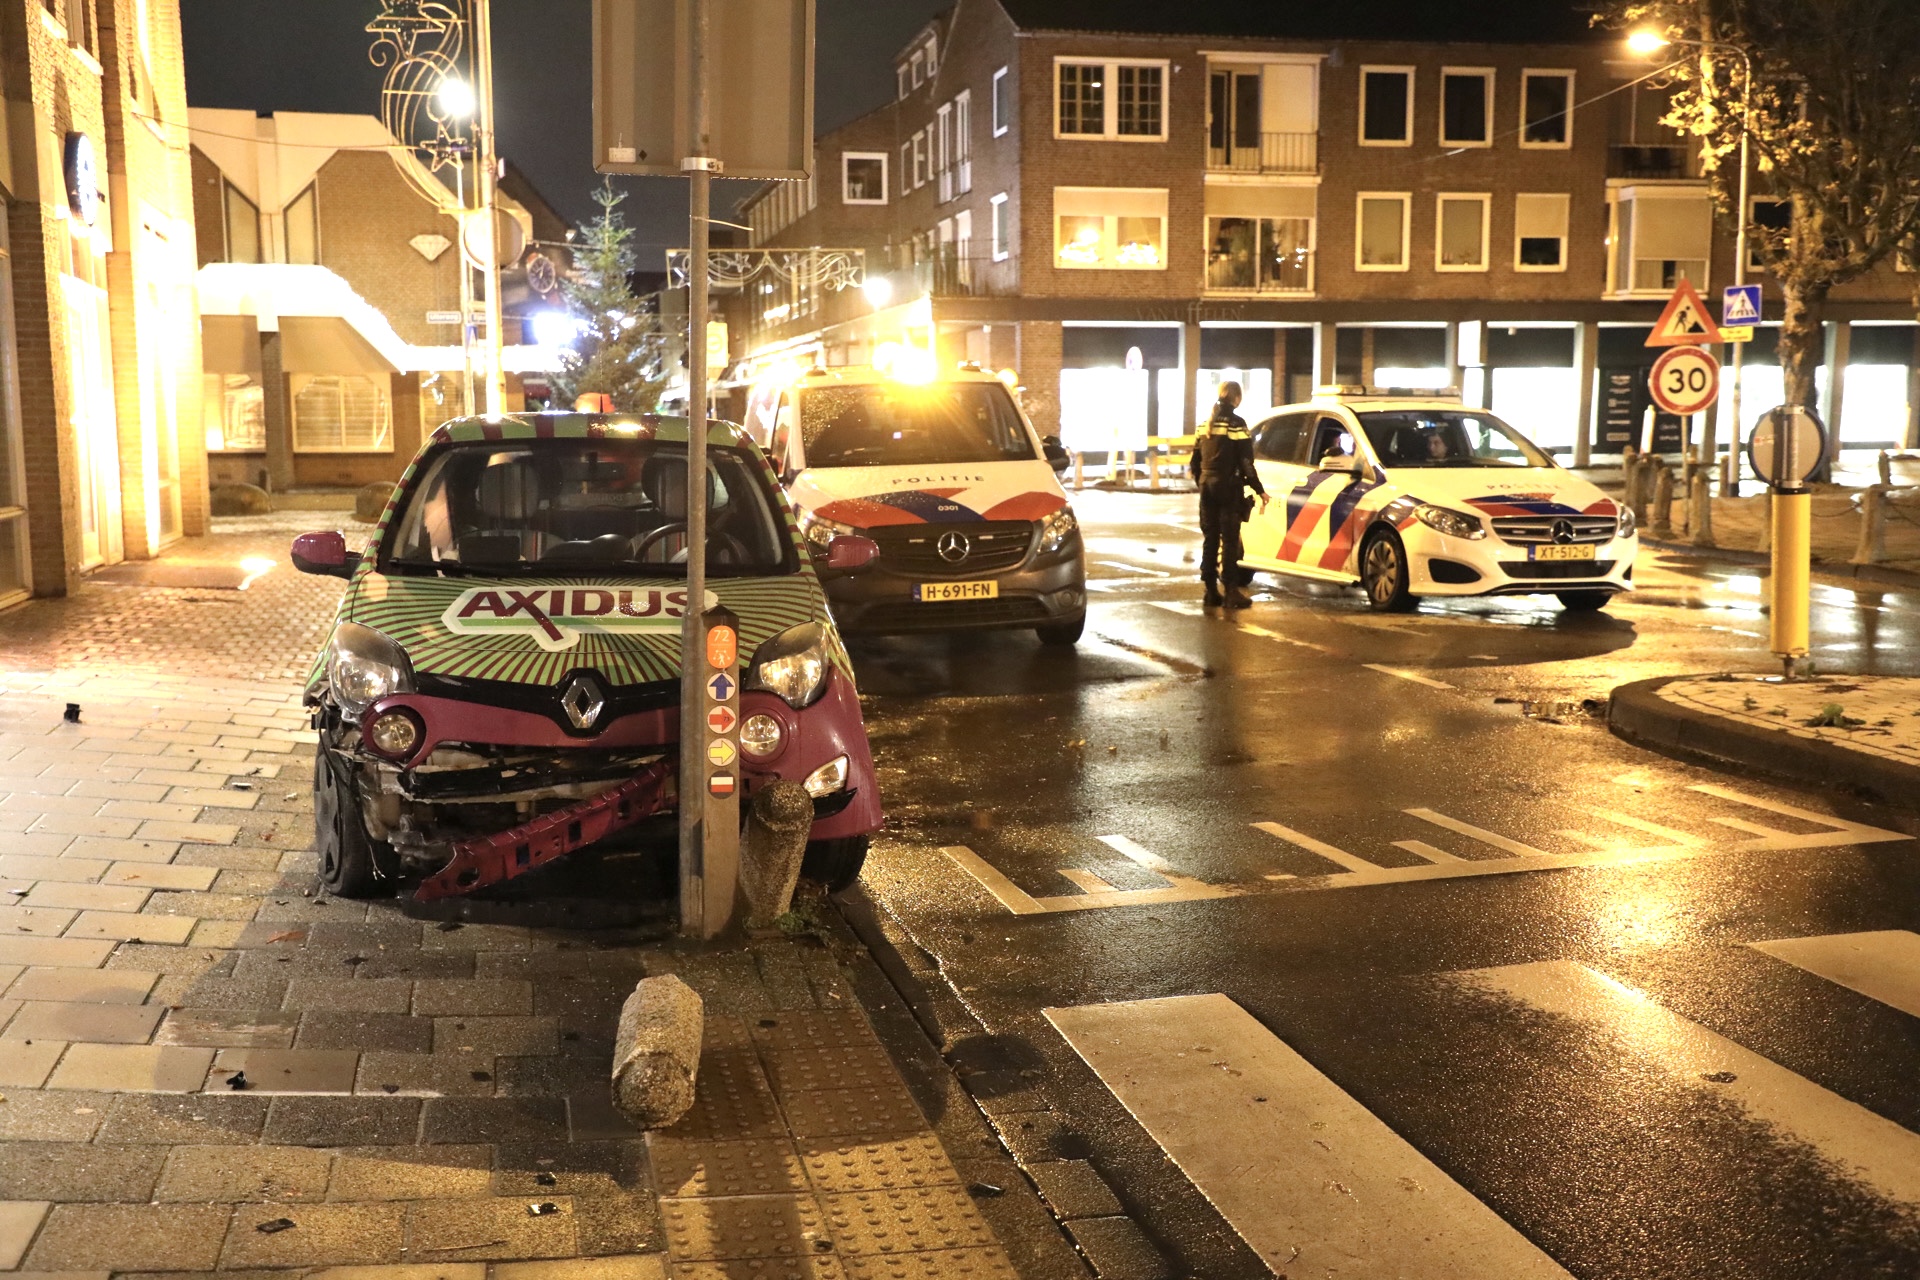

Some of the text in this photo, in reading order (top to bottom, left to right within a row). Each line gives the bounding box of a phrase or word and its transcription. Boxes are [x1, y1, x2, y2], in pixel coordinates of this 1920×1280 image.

[1668, 367, 1707, 394] 30
[892, 475, 985, 485] POLITIE
[937, 504, 959, 512] 0301
[1540, 546, 1589, 559] XT-512-G
[926, 583, 991, 599] H-691-FN
[457, 589, 690, 642] AXIDUS
[713, 629, 731, 643] 72
